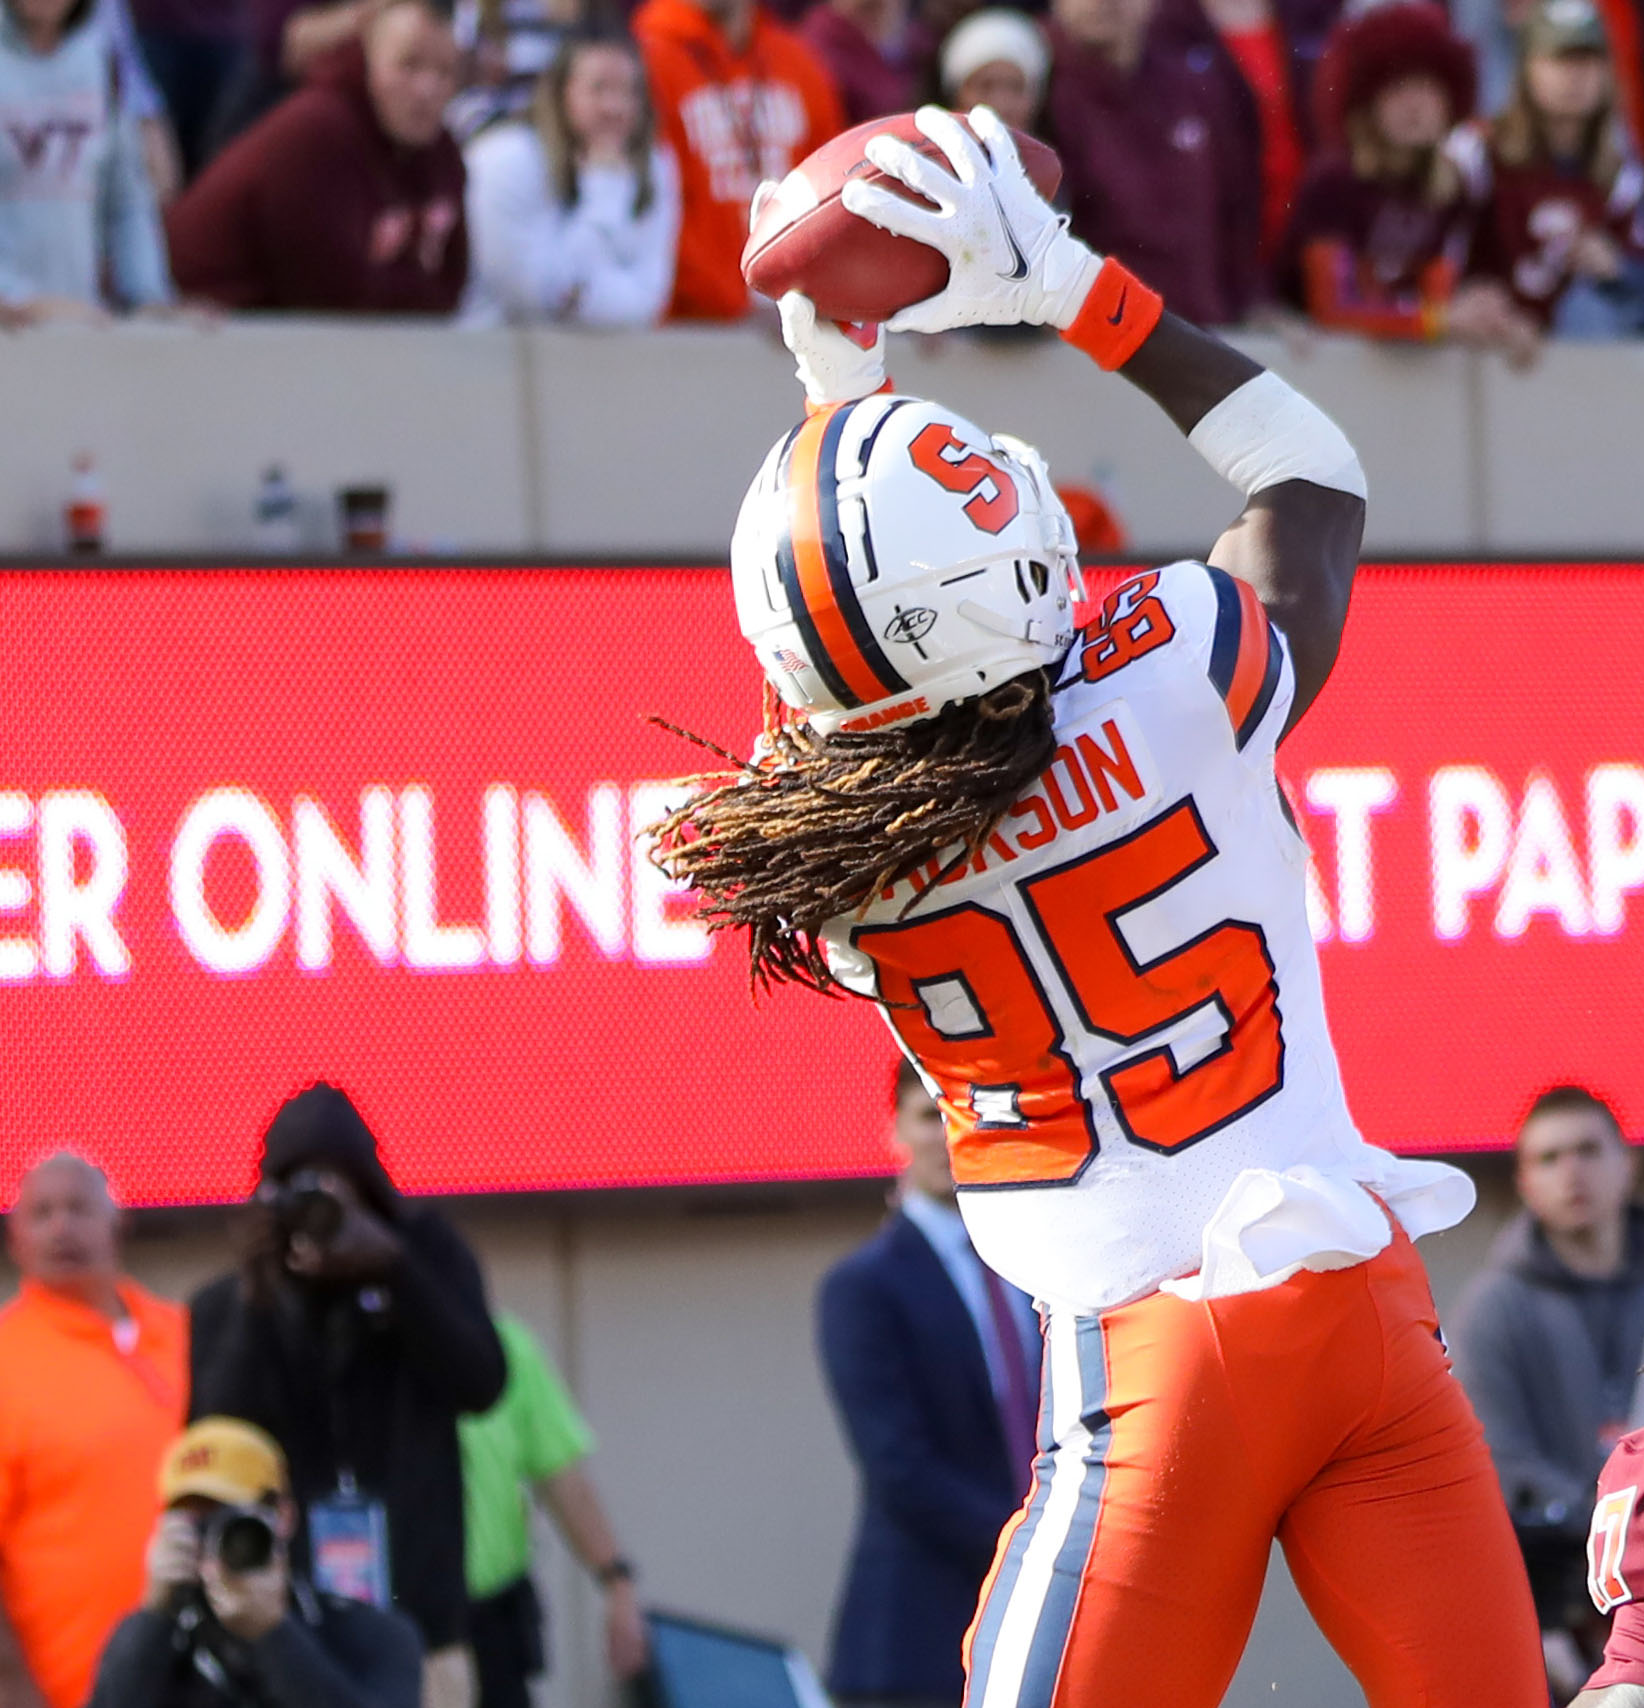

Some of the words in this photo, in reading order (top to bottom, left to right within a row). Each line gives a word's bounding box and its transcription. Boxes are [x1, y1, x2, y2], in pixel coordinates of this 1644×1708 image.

[908, 422, 1020, 535] S
[169, 780, 716, 974] ONLINE
[849, 793, 1287, 1191] 85
